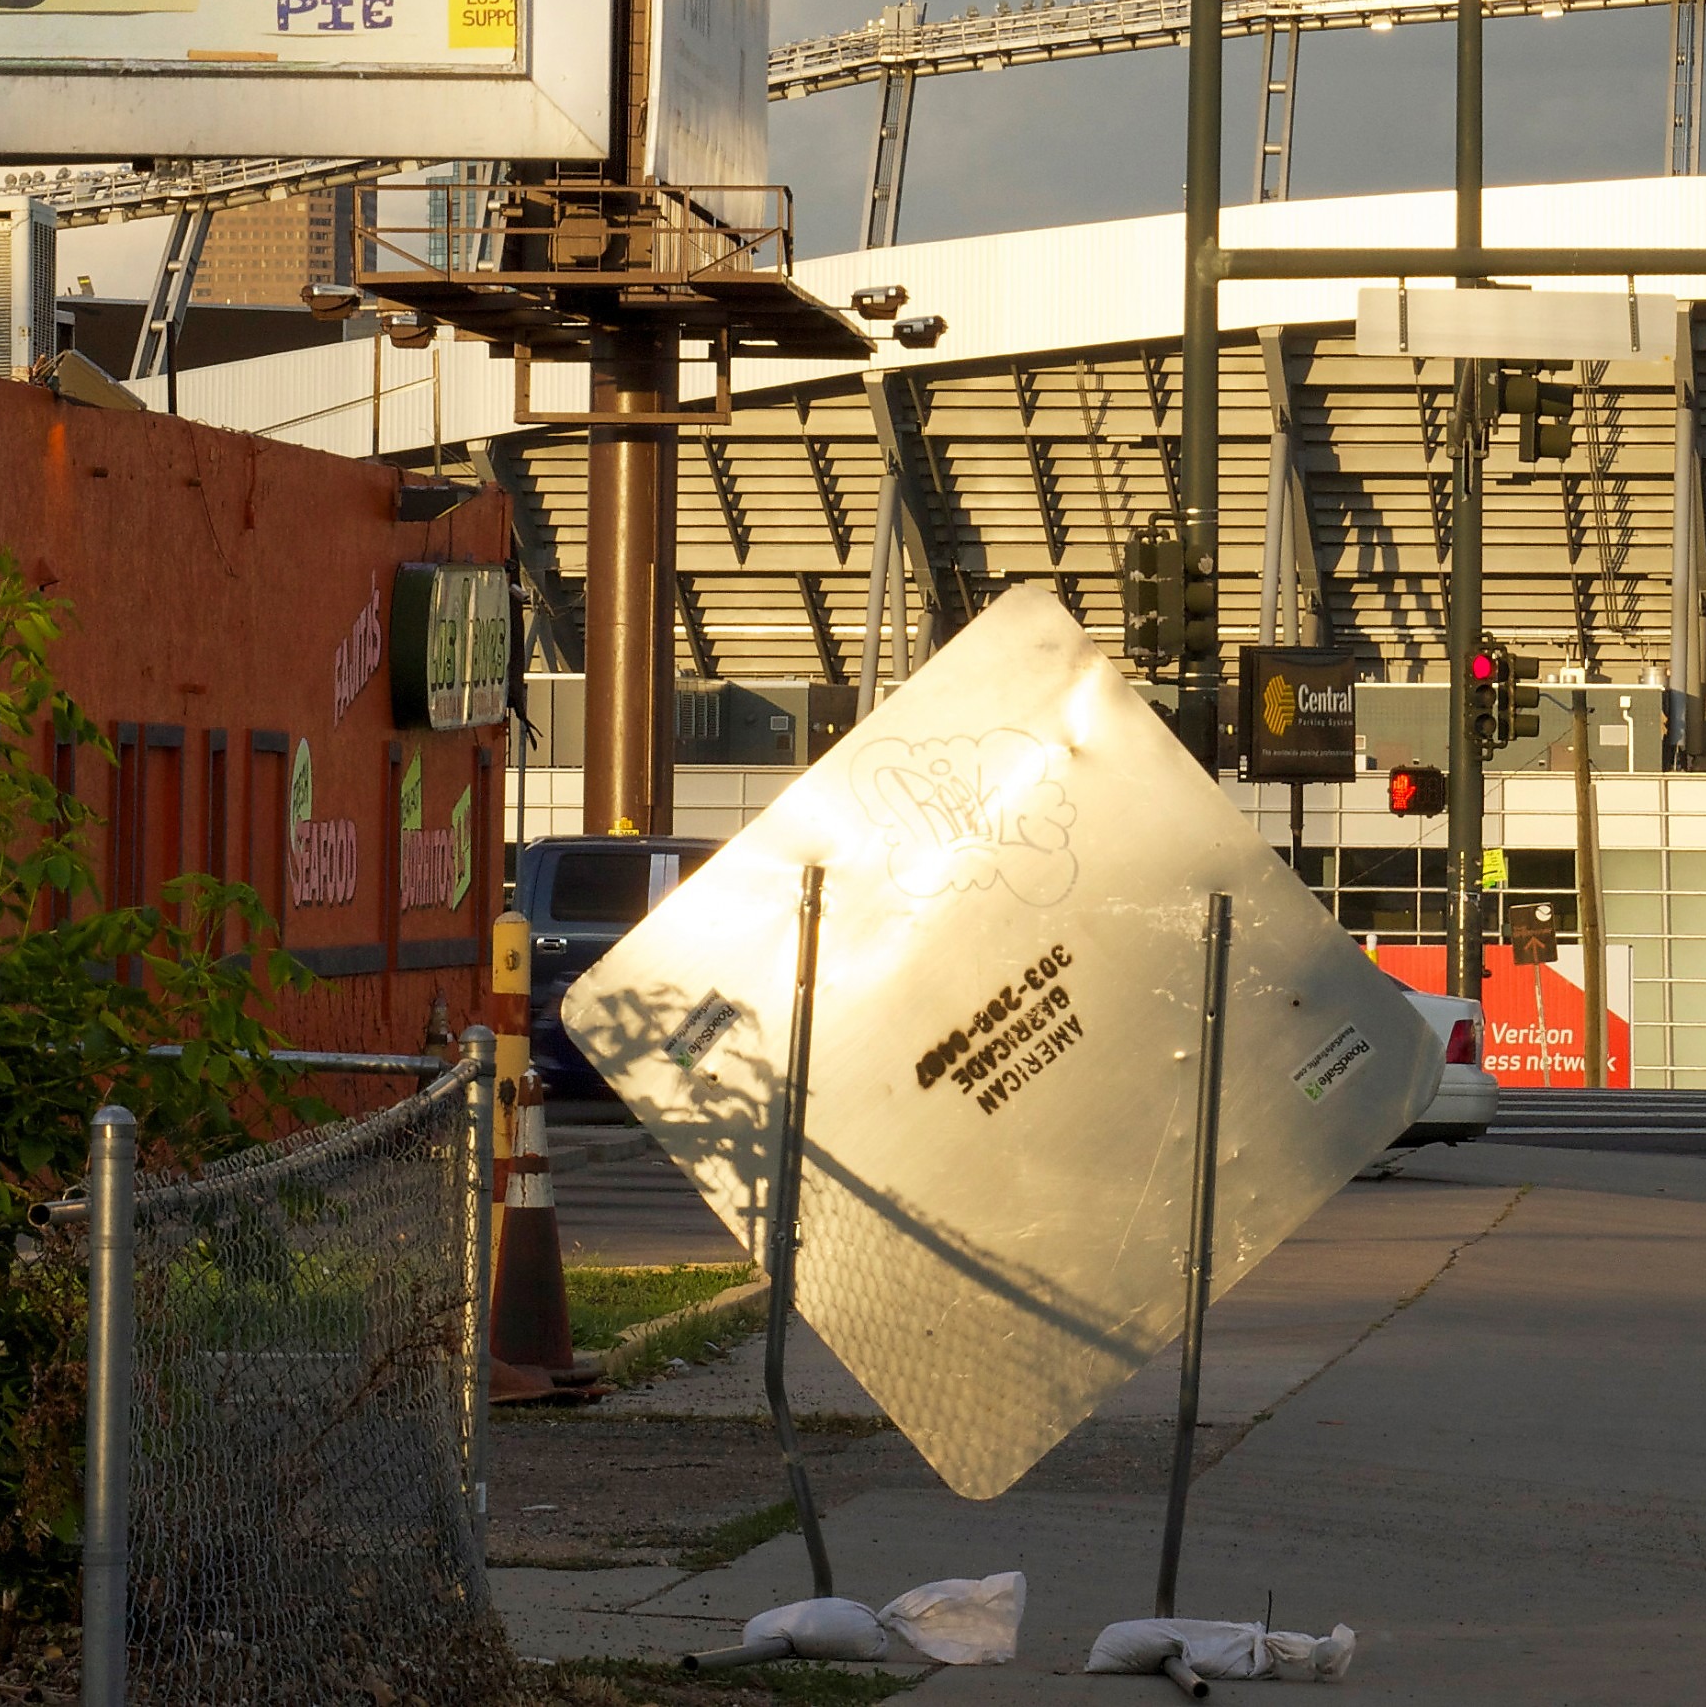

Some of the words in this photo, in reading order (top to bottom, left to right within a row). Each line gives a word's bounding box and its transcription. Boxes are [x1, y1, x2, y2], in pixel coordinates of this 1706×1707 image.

[334, 584, 381, 728] FAJITAS
[1298, 683, 1353, 713] Central
[289, 818, 357, 907] SEAFOOD
[950, 985, 1071, 1095] BARRICADE
[976, 1014, 1084, 1115] AMERICAN
[1317, 1040, 1370, 1086] RoadSafe
[1492, 1022, 1573, 1044] Verizon
